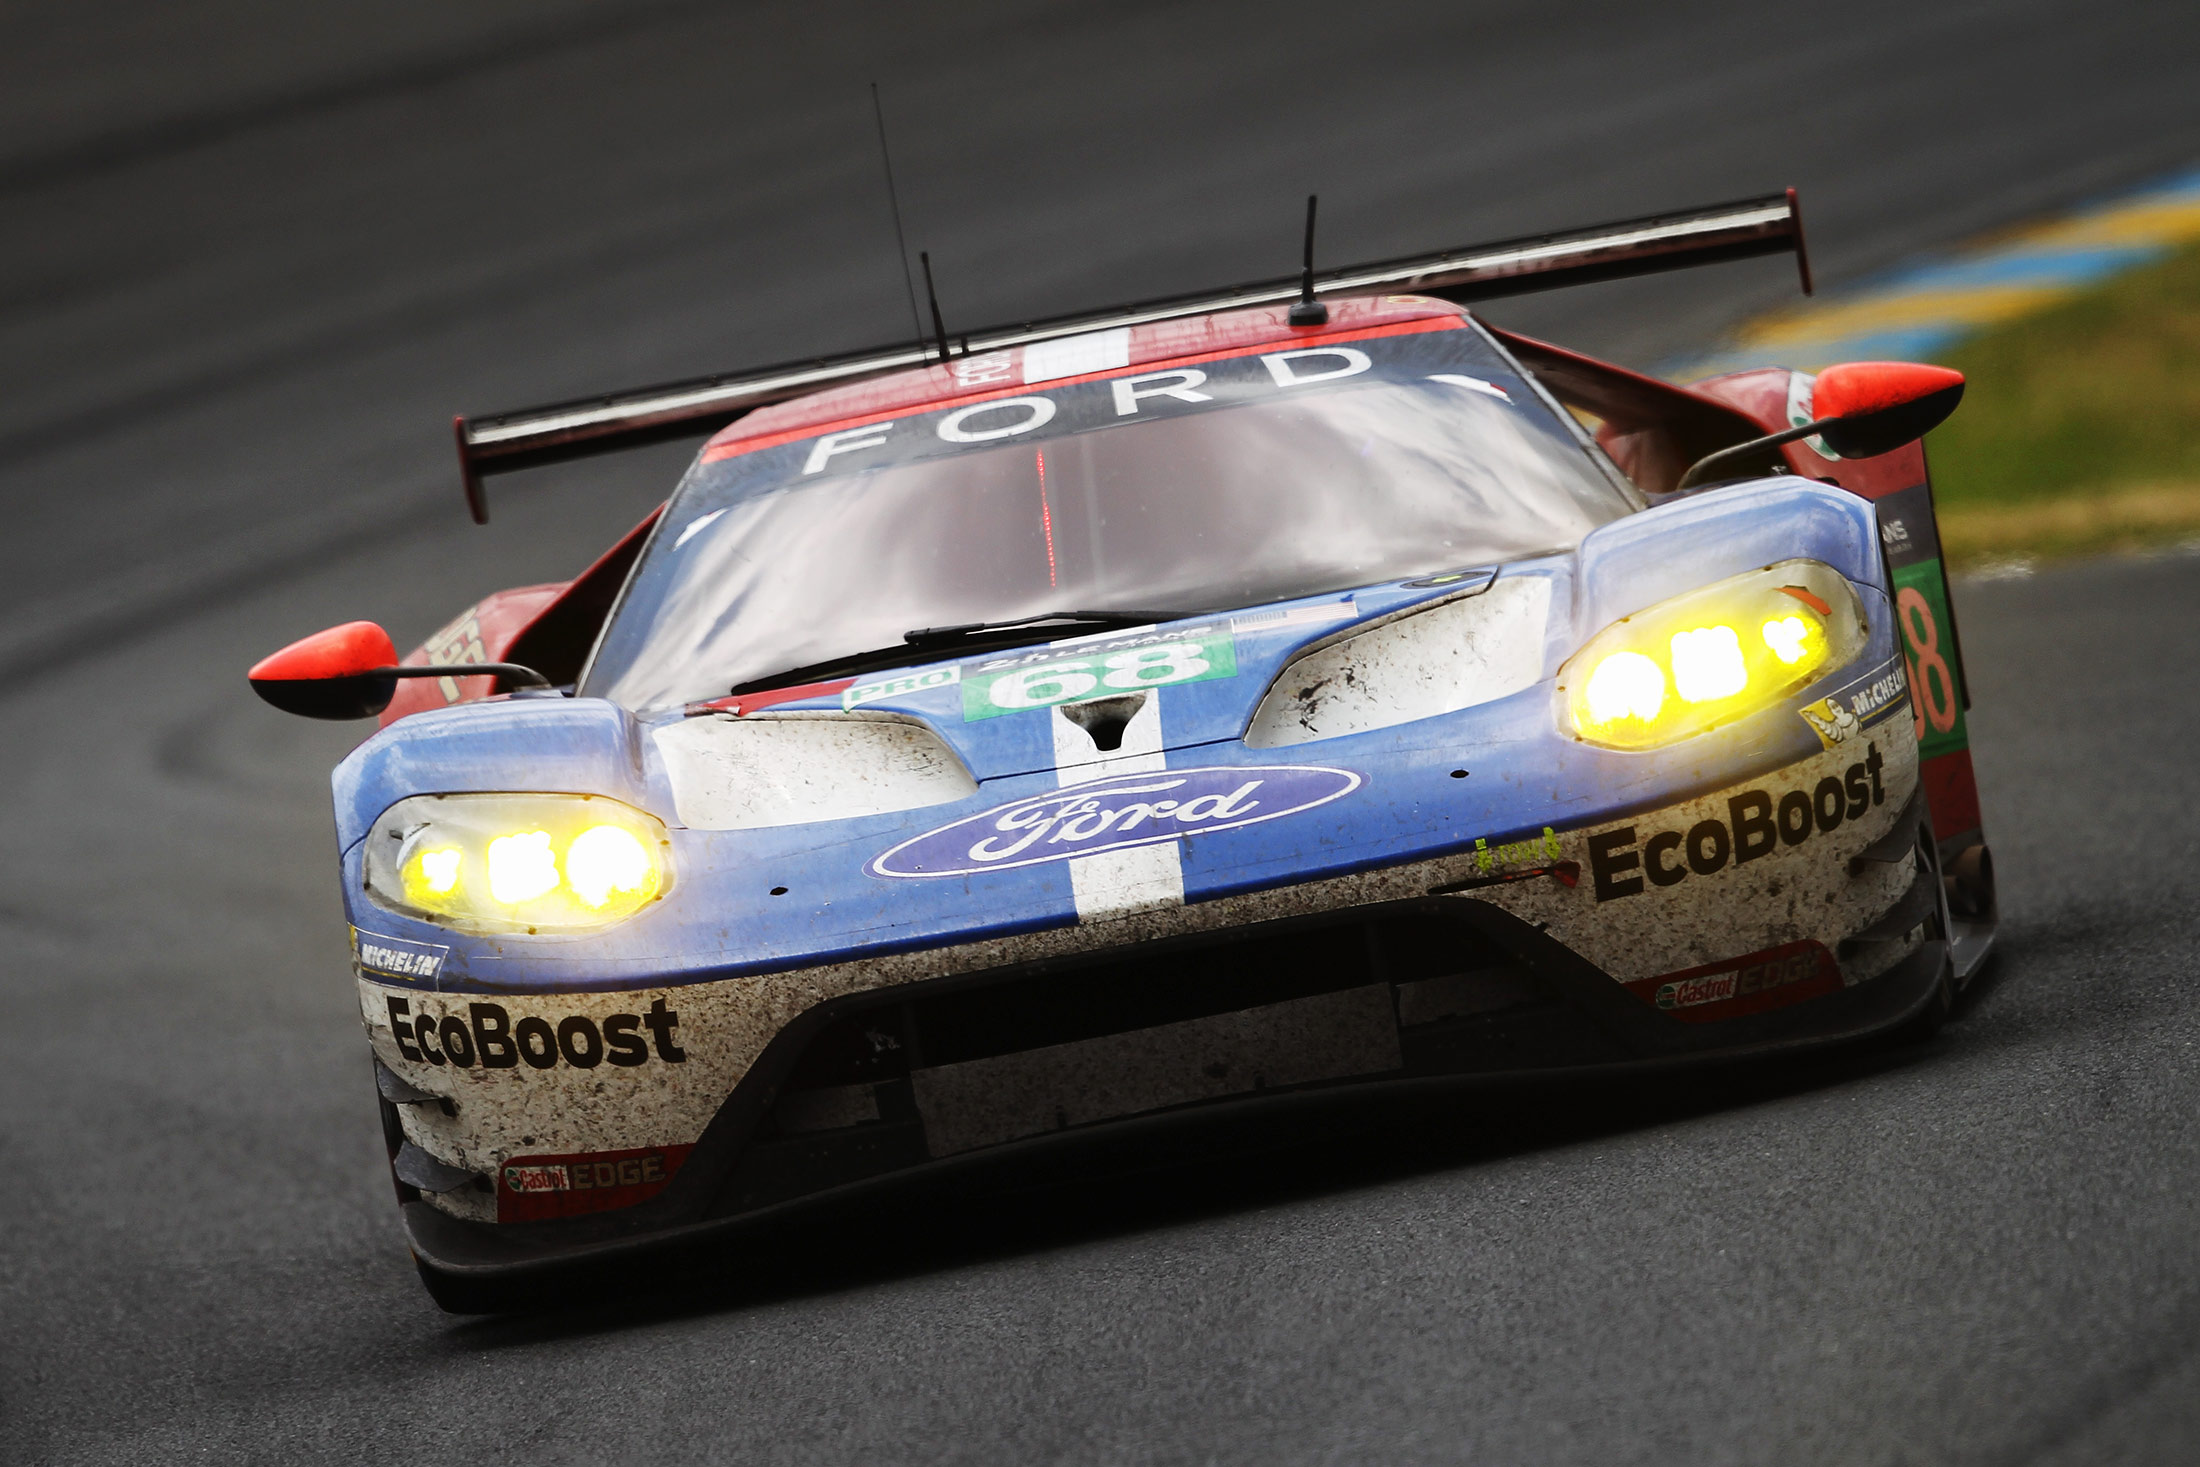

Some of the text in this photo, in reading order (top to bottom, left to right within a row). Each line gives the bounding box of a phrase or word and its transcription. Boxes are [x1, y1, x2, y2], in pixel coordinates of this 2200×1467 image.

[803, 345, 1372, 475] FORD
[851, 672, 952, 700] PRO
[989, 644, 1210, 708] 68
[969, 779, 1264, 862] Ford
[1588, 741, 1884, 902] EcoBoost
[361, 943, 441, 977] MICHELIN
[387, 995, 687, 1070] EcoBoost
[572, 1156, 667, 1190] EDGE
